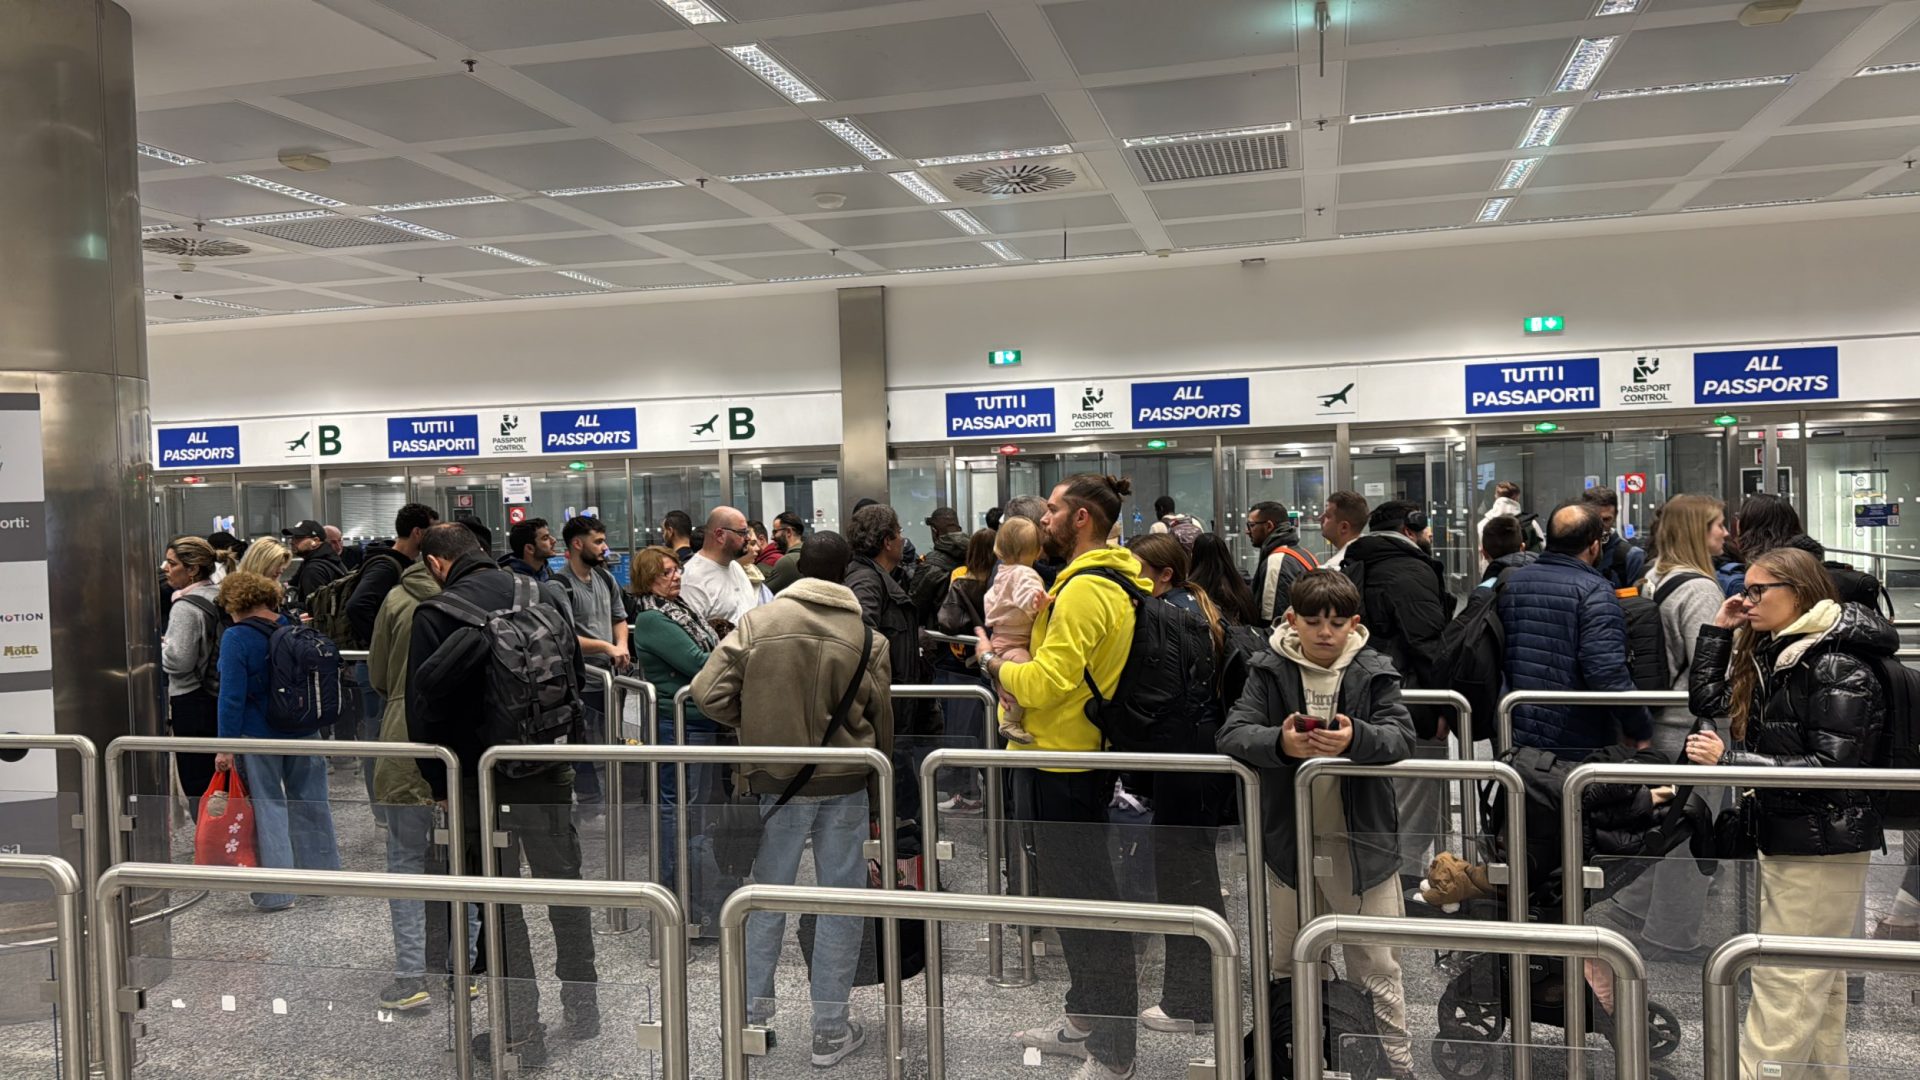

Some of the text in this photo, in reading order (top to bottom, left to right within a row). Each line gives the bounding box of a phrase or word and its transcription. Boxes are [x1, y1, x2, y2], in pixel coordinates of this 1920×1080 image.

[1744, 356, 1783, 371] ALL
[1500, 366, 1564, 383] TUTTI I
[1620, 383, 1672, 393] PASSPORT
[1702, 375, 1829, 395] PASSPORTS
[1172, 386, 1204, 401] ALL
[1472, 386, 1595, 407] PASSAPORTI
[1623, 393, 1668, 402] CONTROL
[974, 395, 1026, 410] TUTTI I
[1071, 412, 1114, 420] PASSPORT
[1138, 404, 1242, 422] PASSPORTS
[411, 420, 455, 434] TUTTI I
[574, 415, 601, 428] ALL
[728, 406, 756, 440] B
[952, 413, 1051, 431] PASSAPORTI
[1074, 420, 1111, 429] CONTROL
[186, 431, 209, 444] ALL
[318, 424, 342, 456] B
[547, 431, 631, 446] PASSPORTS
[392, 438, 476, 453] PASSAPORTI
[163, 447, 235, 462] PASSPORTS
[3, 645, 39, 656] Motta
